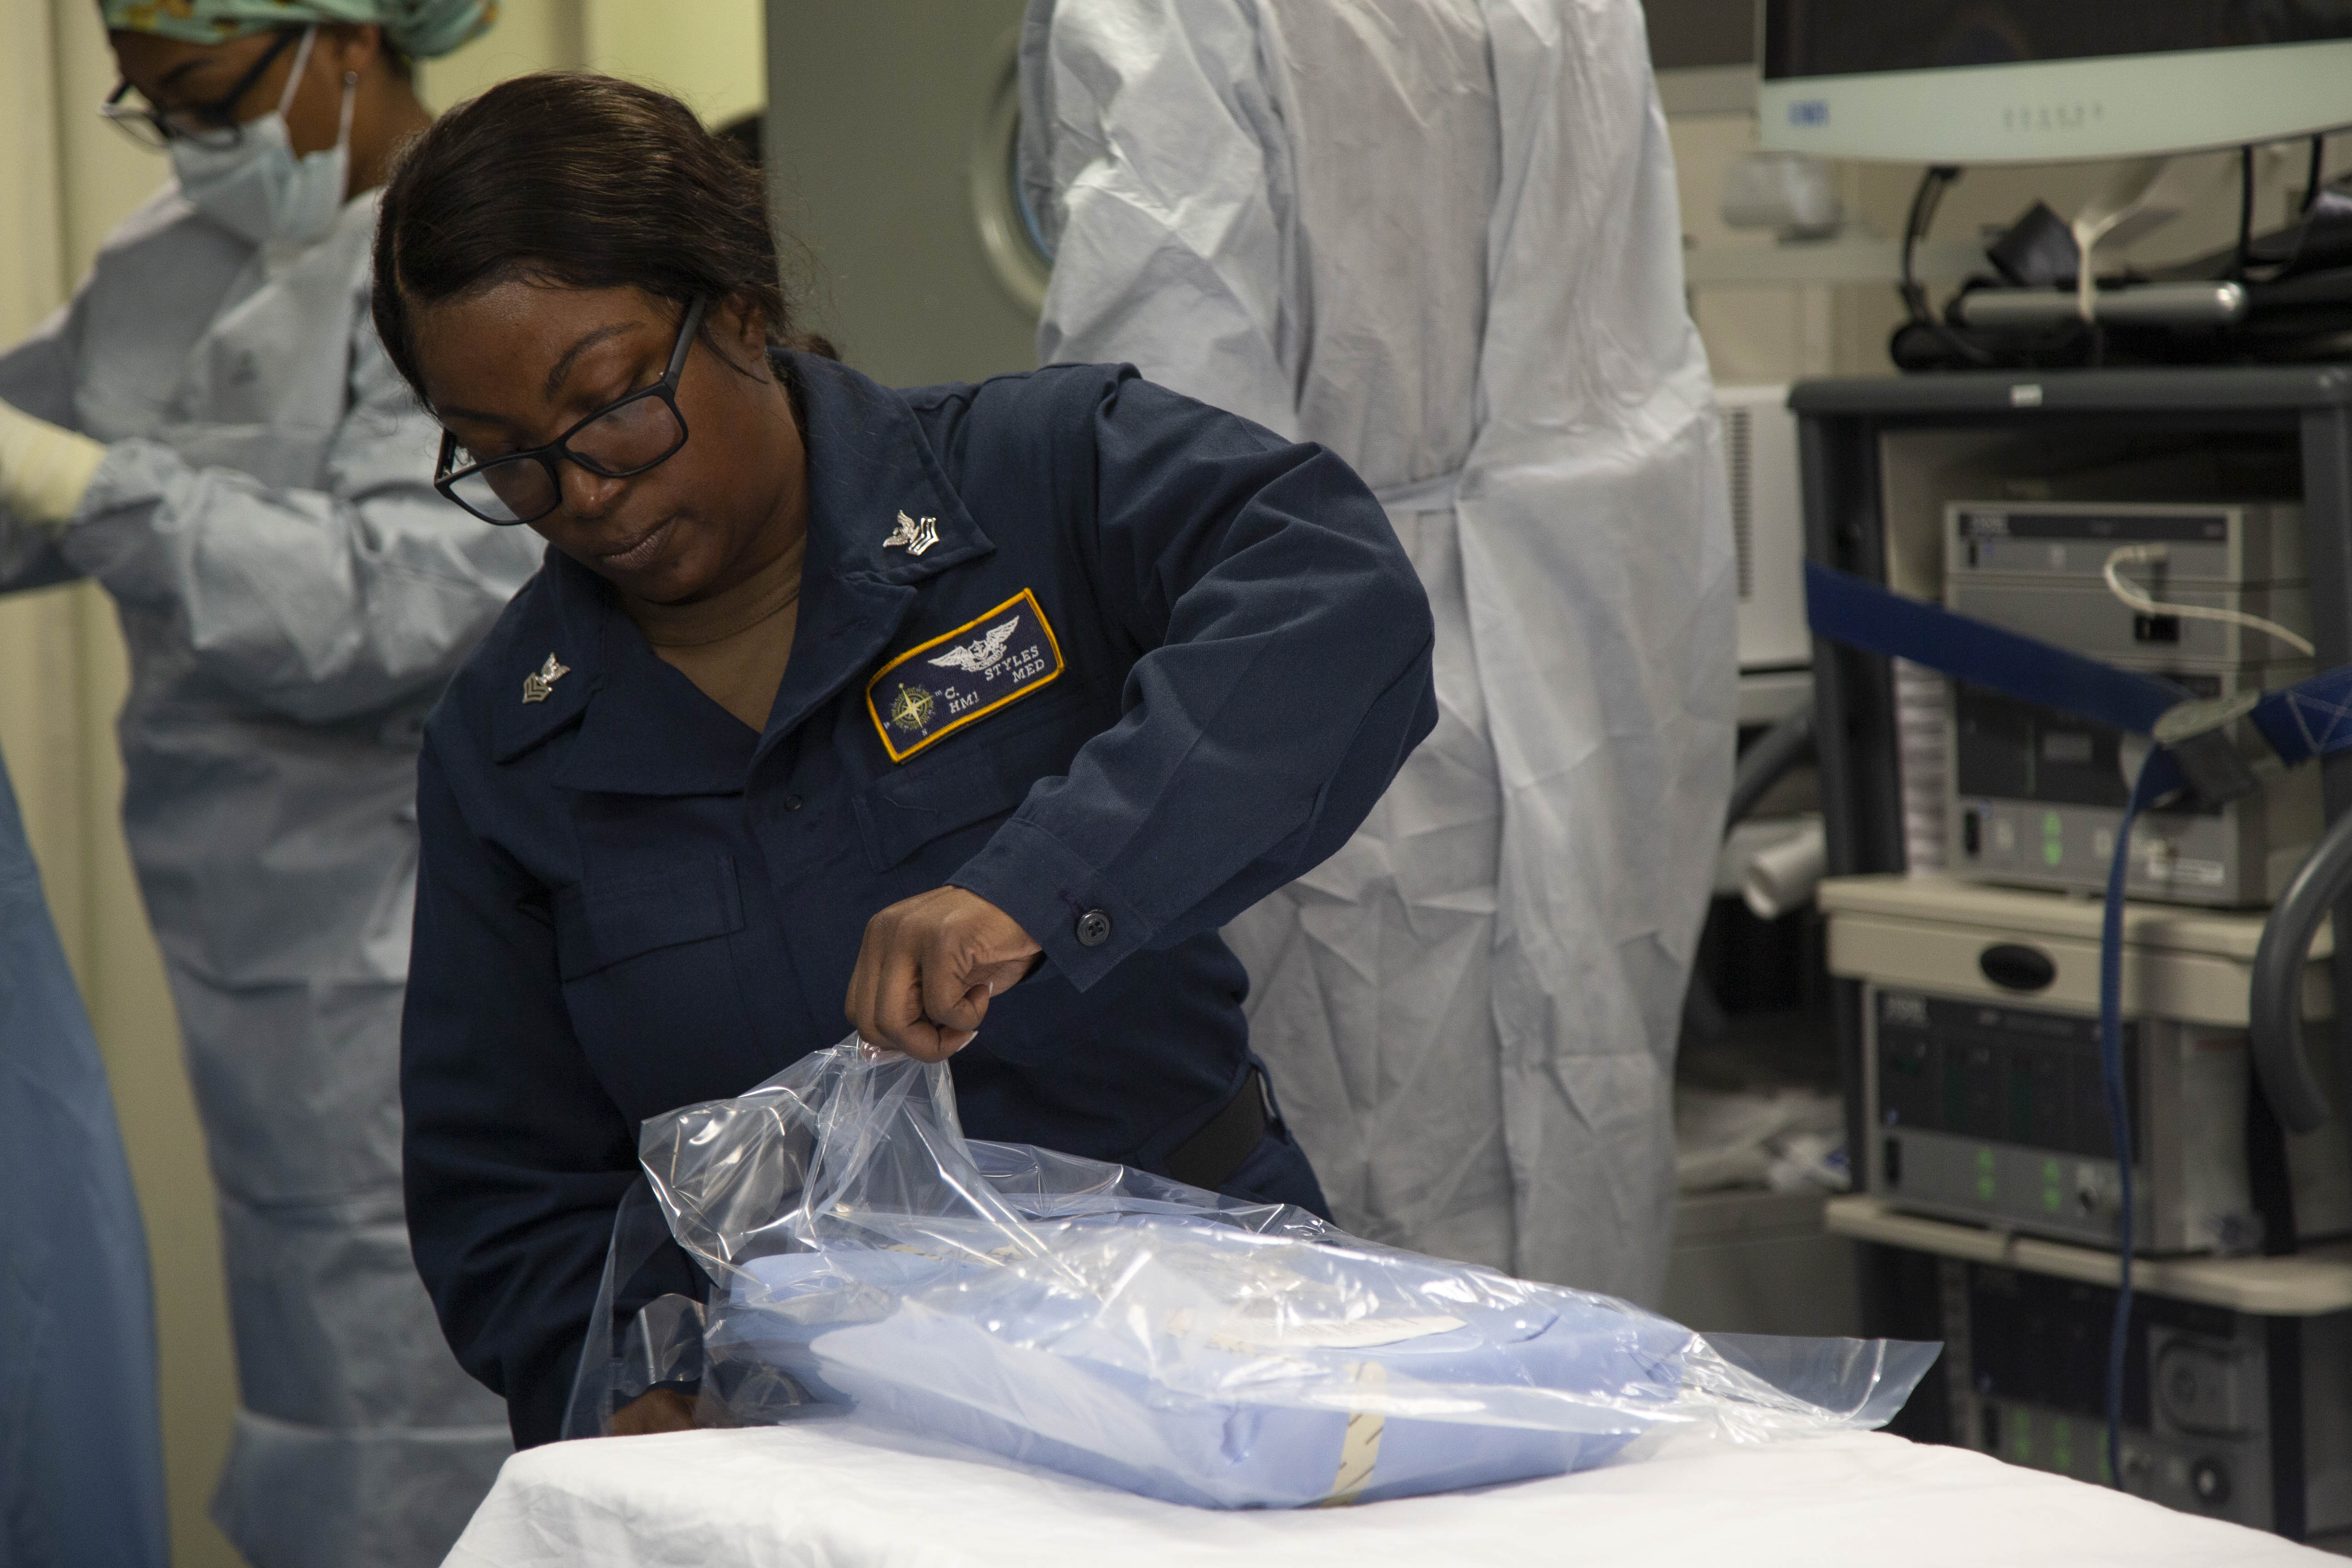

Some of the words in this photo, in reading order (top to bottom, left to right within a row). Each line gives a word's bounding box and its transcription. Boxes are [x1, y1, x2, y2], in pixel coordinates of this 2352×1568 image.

[945, 686, 960, 699] C.
[985, 645, 1039, 681] STYLES
[949, 691, 980, 714] HM1
[1012, 659, 1044, 683] MED
